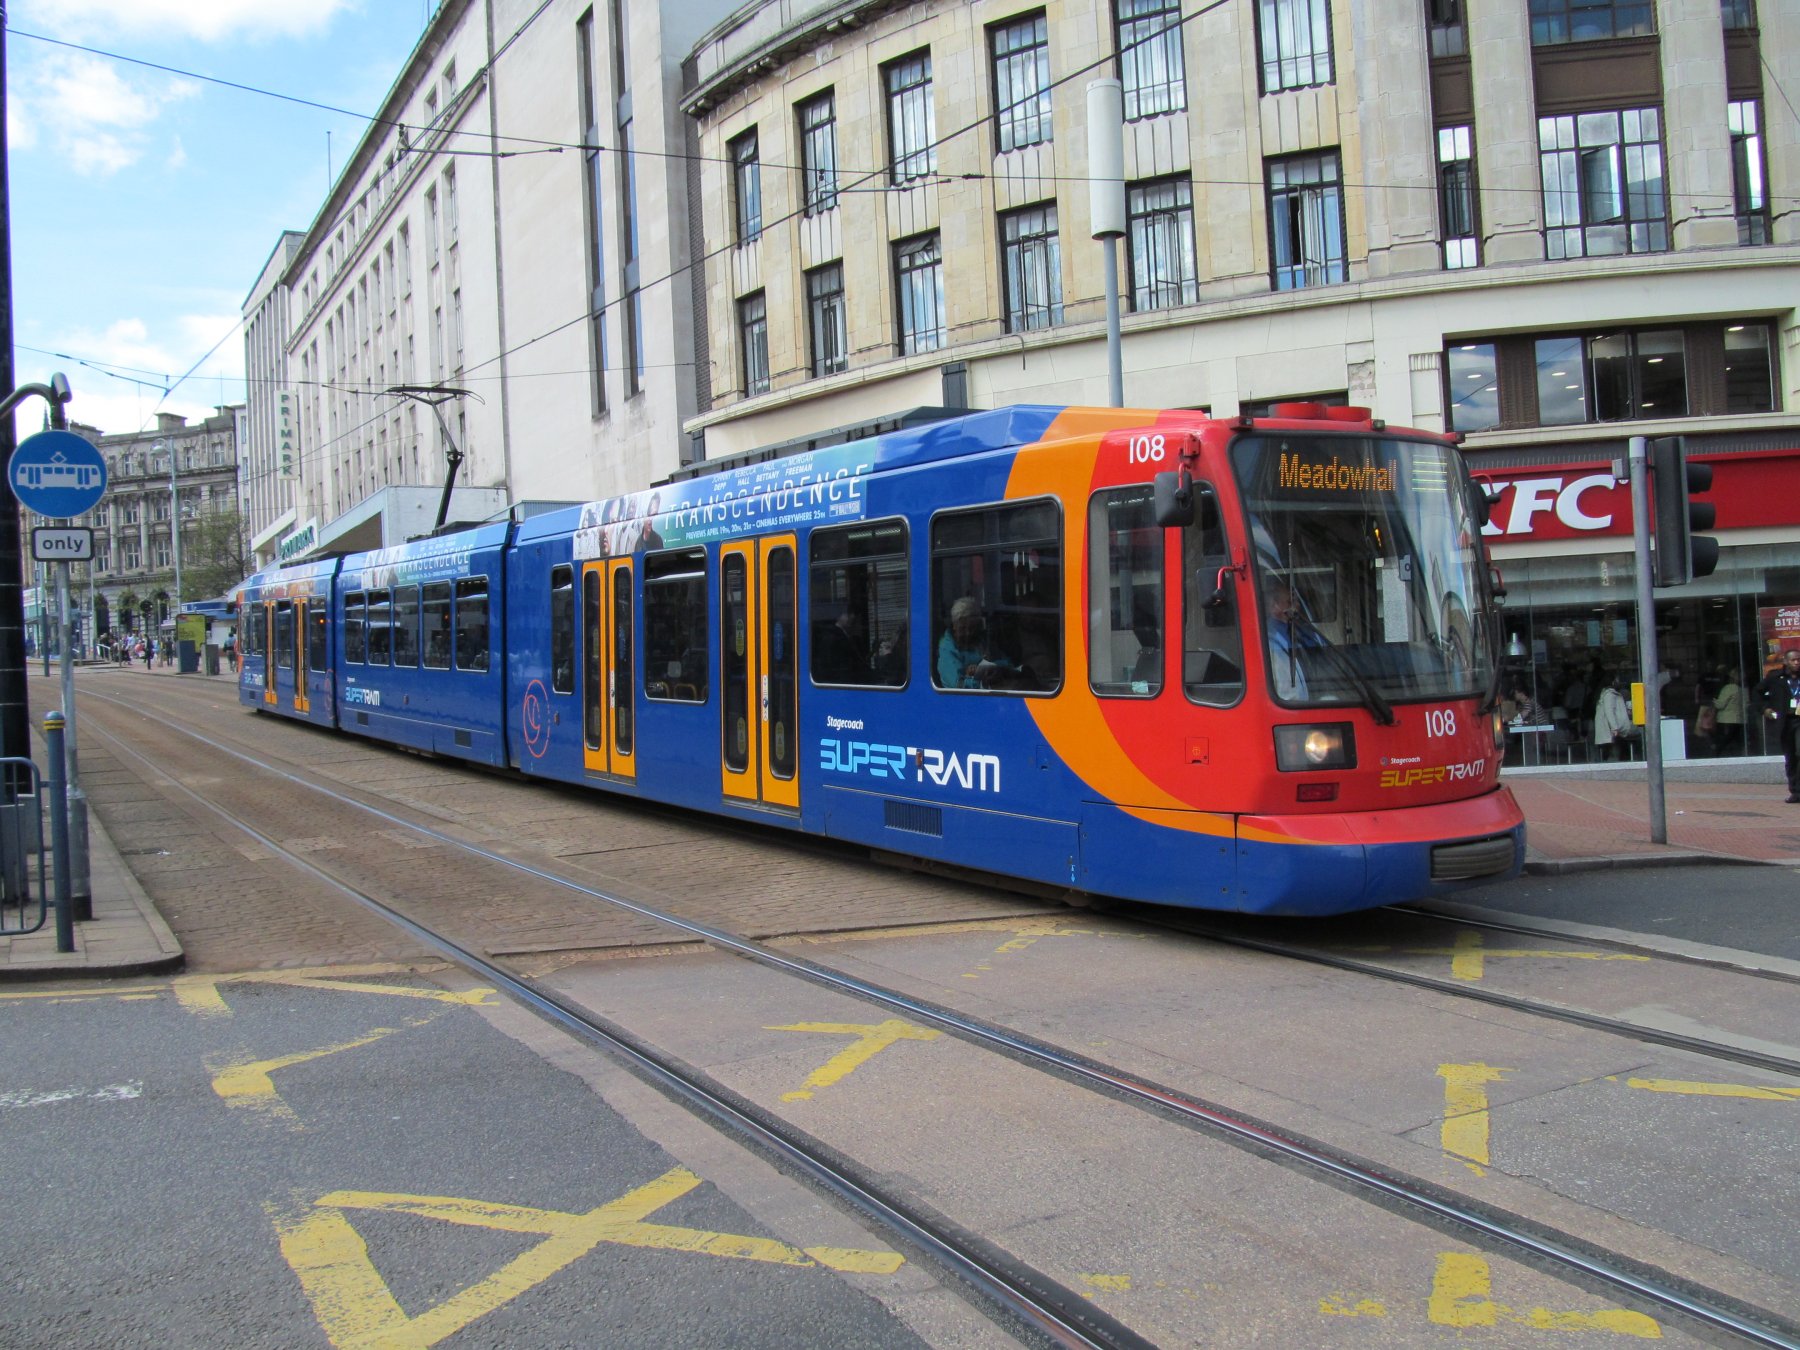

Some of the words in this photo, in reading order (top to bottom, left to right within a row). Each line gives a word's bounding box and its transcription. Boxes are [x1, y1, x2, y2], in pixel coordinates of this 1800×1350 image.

[280, 394, 293, 476] PRIMARK
[1129, 434, 1166, 463] 108
[713, 482, 727, 492] DEPP
[737, 476, 750, 487] HALL
[755, 470, 780, 483] BETTANY
[785, 463, 813, 477] FREEMAN
[734, 466, 757, 479] REBECCA
[762, 463, 776, 472] PAUL
[788, 453, 814, 467] MORGAN
[1280, 453, 1397, 492] Meadowhall
[664, 463, 868, 530] TRANSCENDENCE
[685, 529, 707, 539] PREVIEWS
[707, 528, 719, 536] APRIL
[756, 516, 778, 528] CINEMAS
[779, 510, 812, 525] EVERYWHERE
[813, 509, 826, 520] 25TH
[42, 535, 84, 553] only
[827, 715, 864, 731] Stagecoach
[1425, 709, 1456, 738] 108
[820, 738, 1000, 793] SUPERTRAM
[1380, 759, 1485, 788] SUPERTRAM
[1390, 756, 1421, 766] Stagecoach
